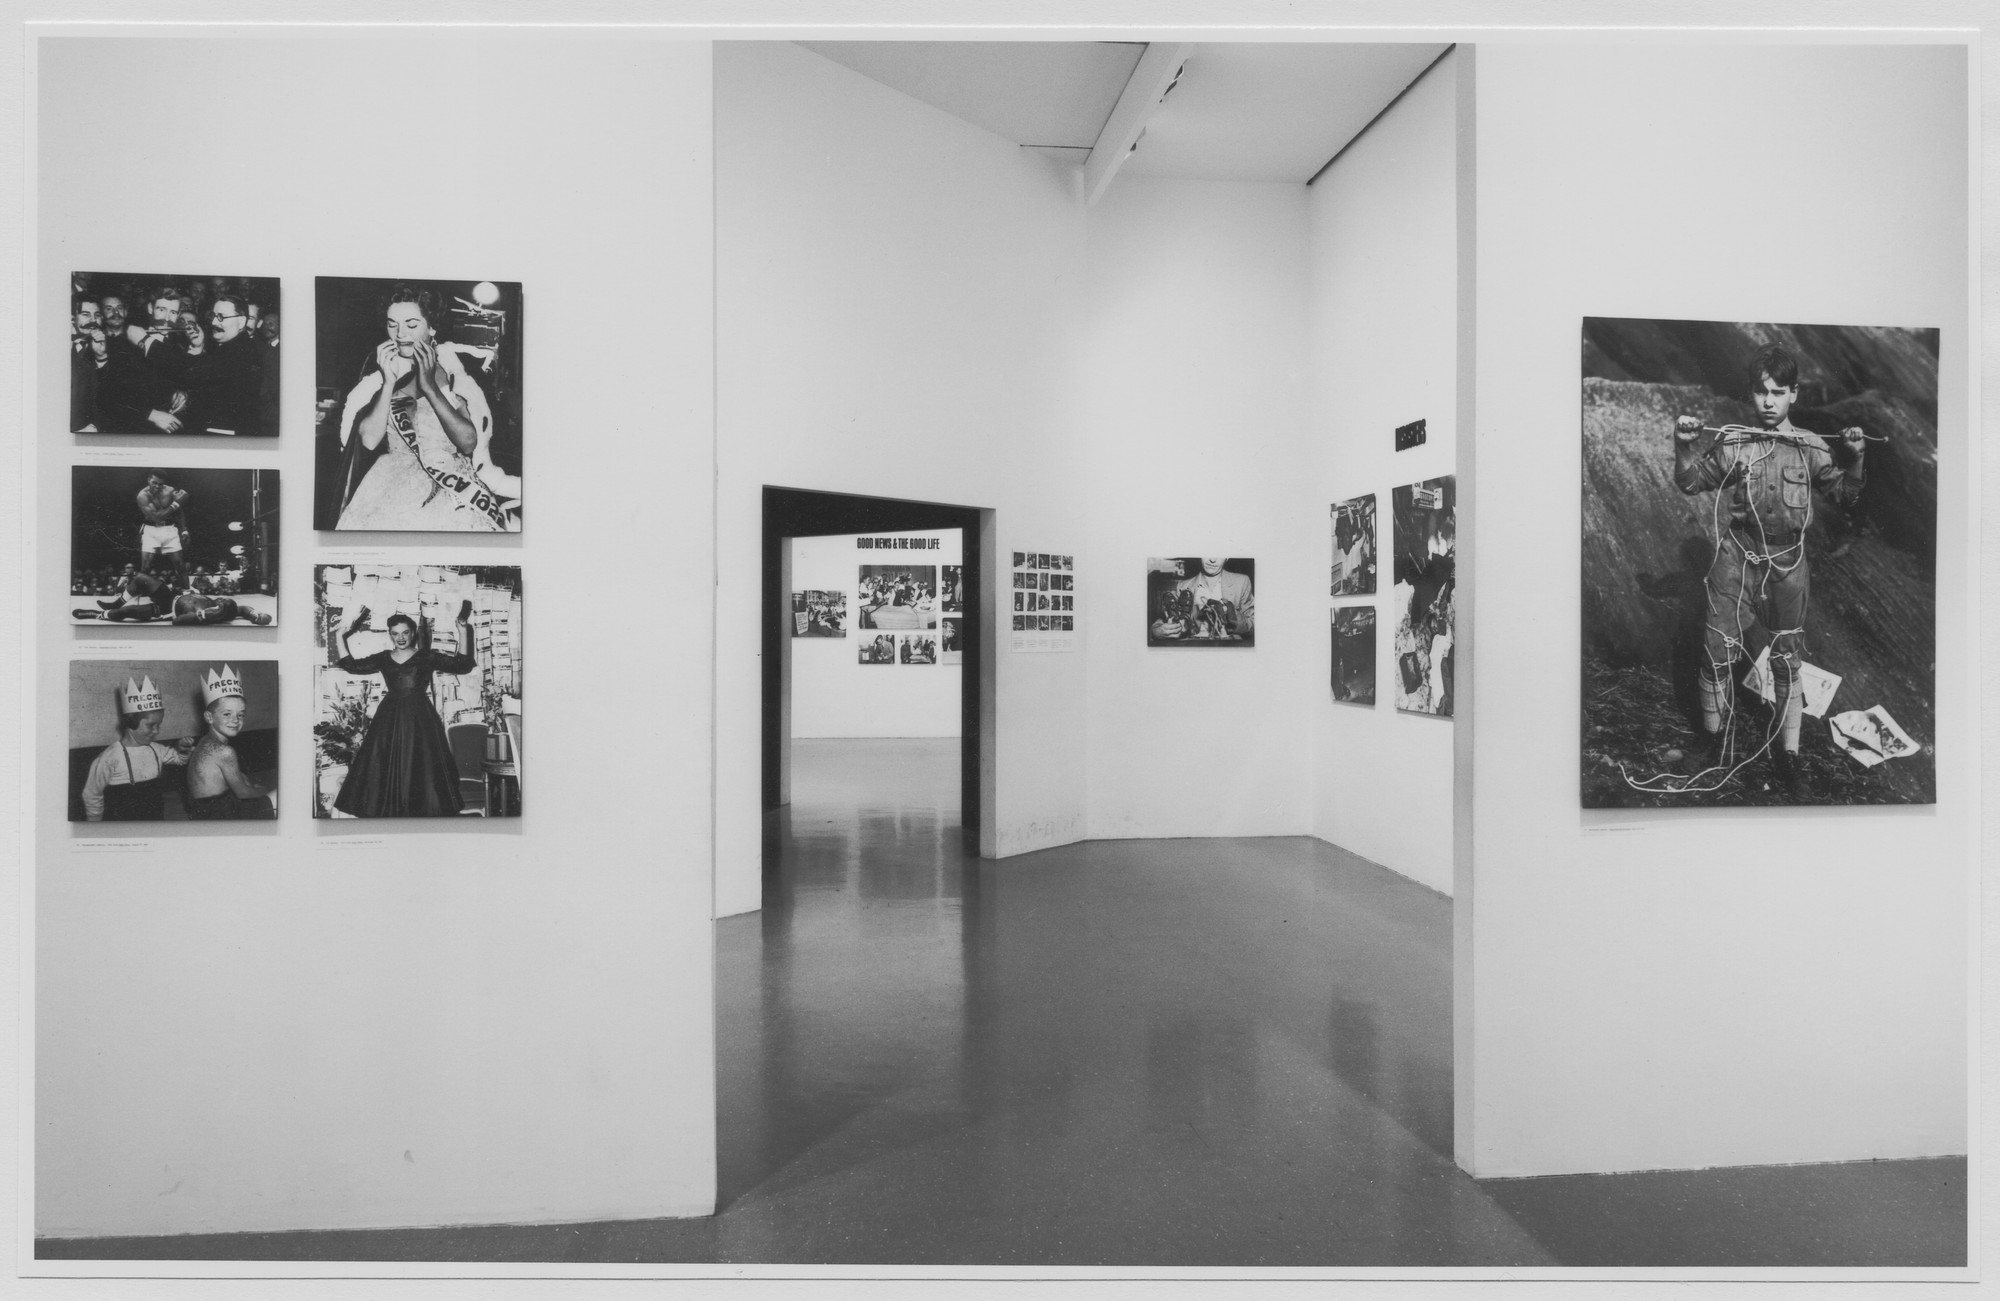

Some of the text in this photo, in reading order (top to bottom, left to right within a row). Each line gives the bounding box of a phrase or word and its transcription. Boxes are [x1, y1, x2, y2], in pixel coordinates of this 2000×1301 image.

[857, 537, 940, 550] GOOD NEWS & THE GOOD LIFE
